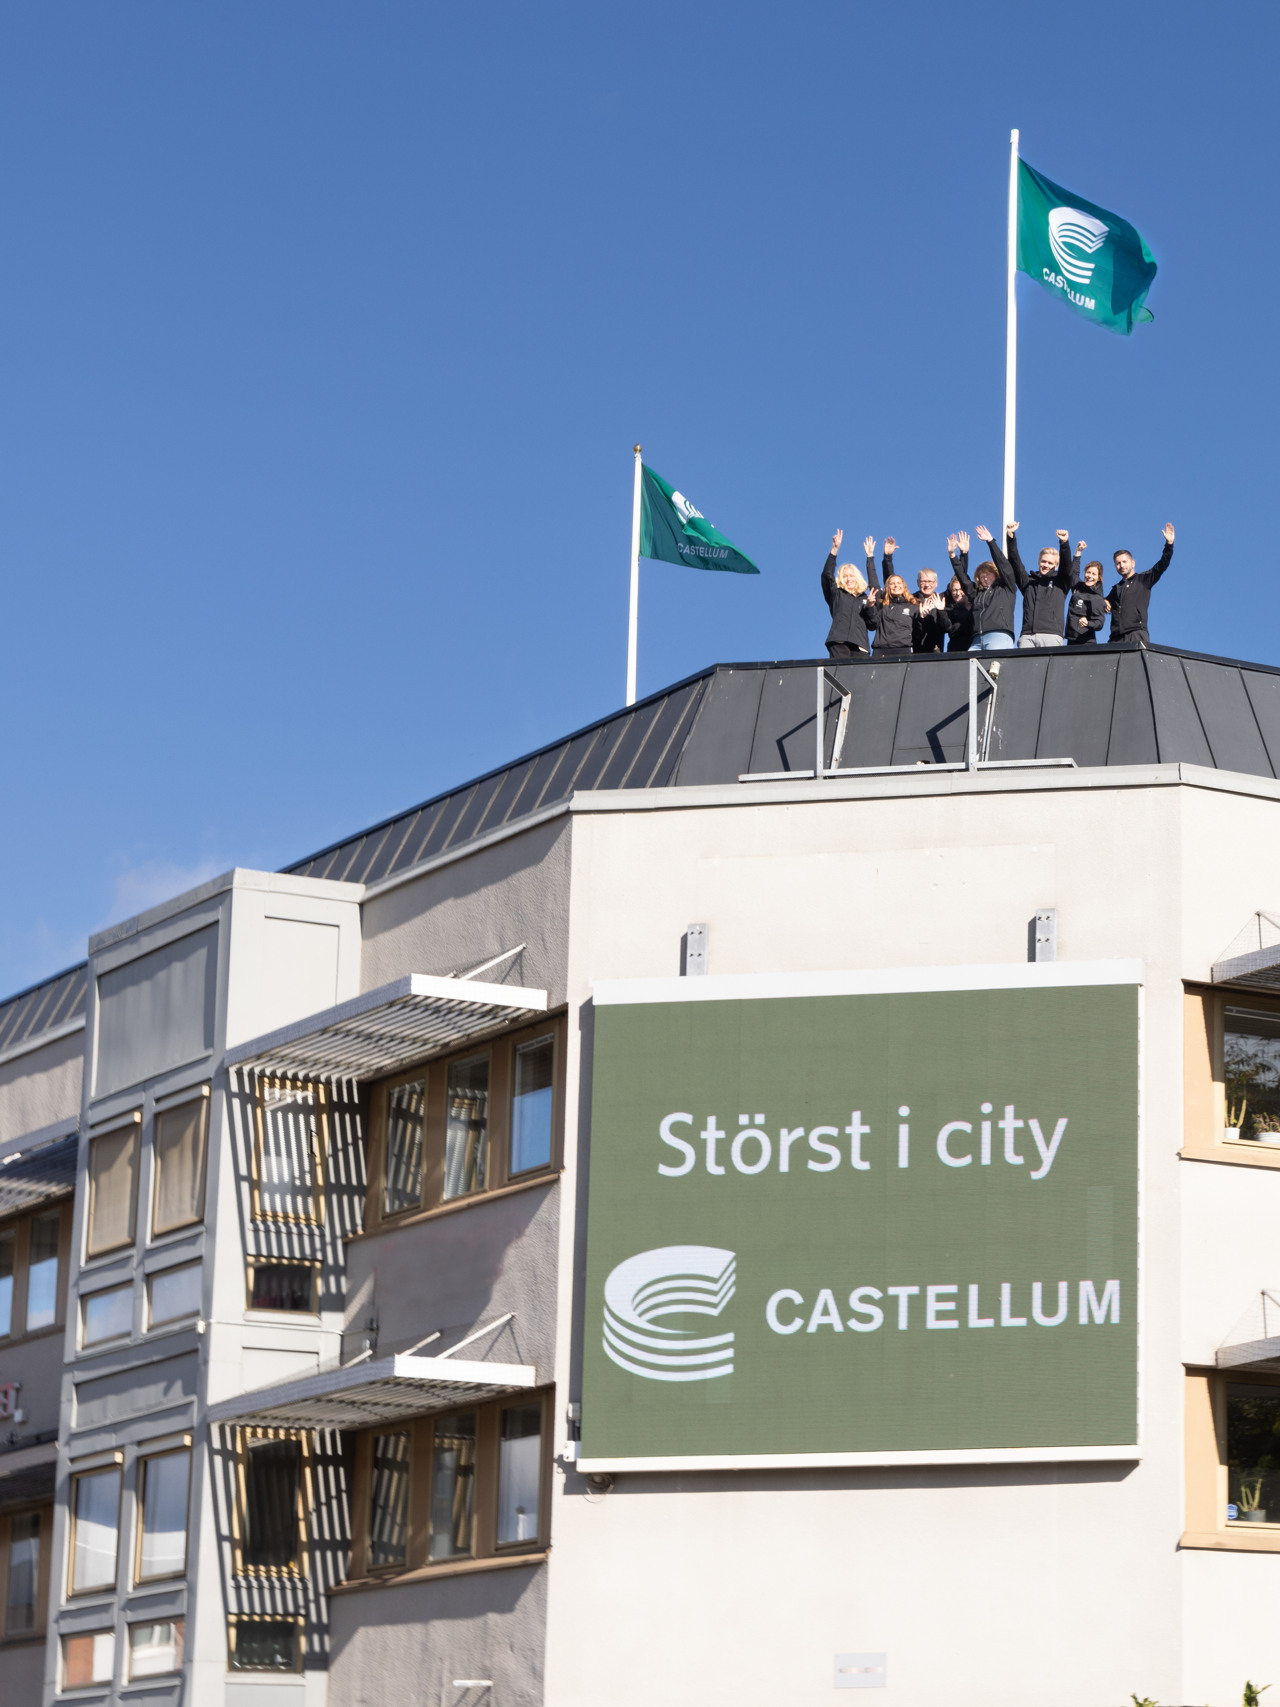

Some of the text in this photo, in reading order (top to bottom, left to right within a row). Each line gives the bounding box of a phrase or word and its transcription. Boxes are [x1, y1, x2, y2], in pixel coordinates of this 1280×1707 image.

[677, 542, 729, 559] CASTELLUM
[657, 1102, 1069, 1180] Störst i city
[765, 1279, 1121, 1335] CASTELLUM
